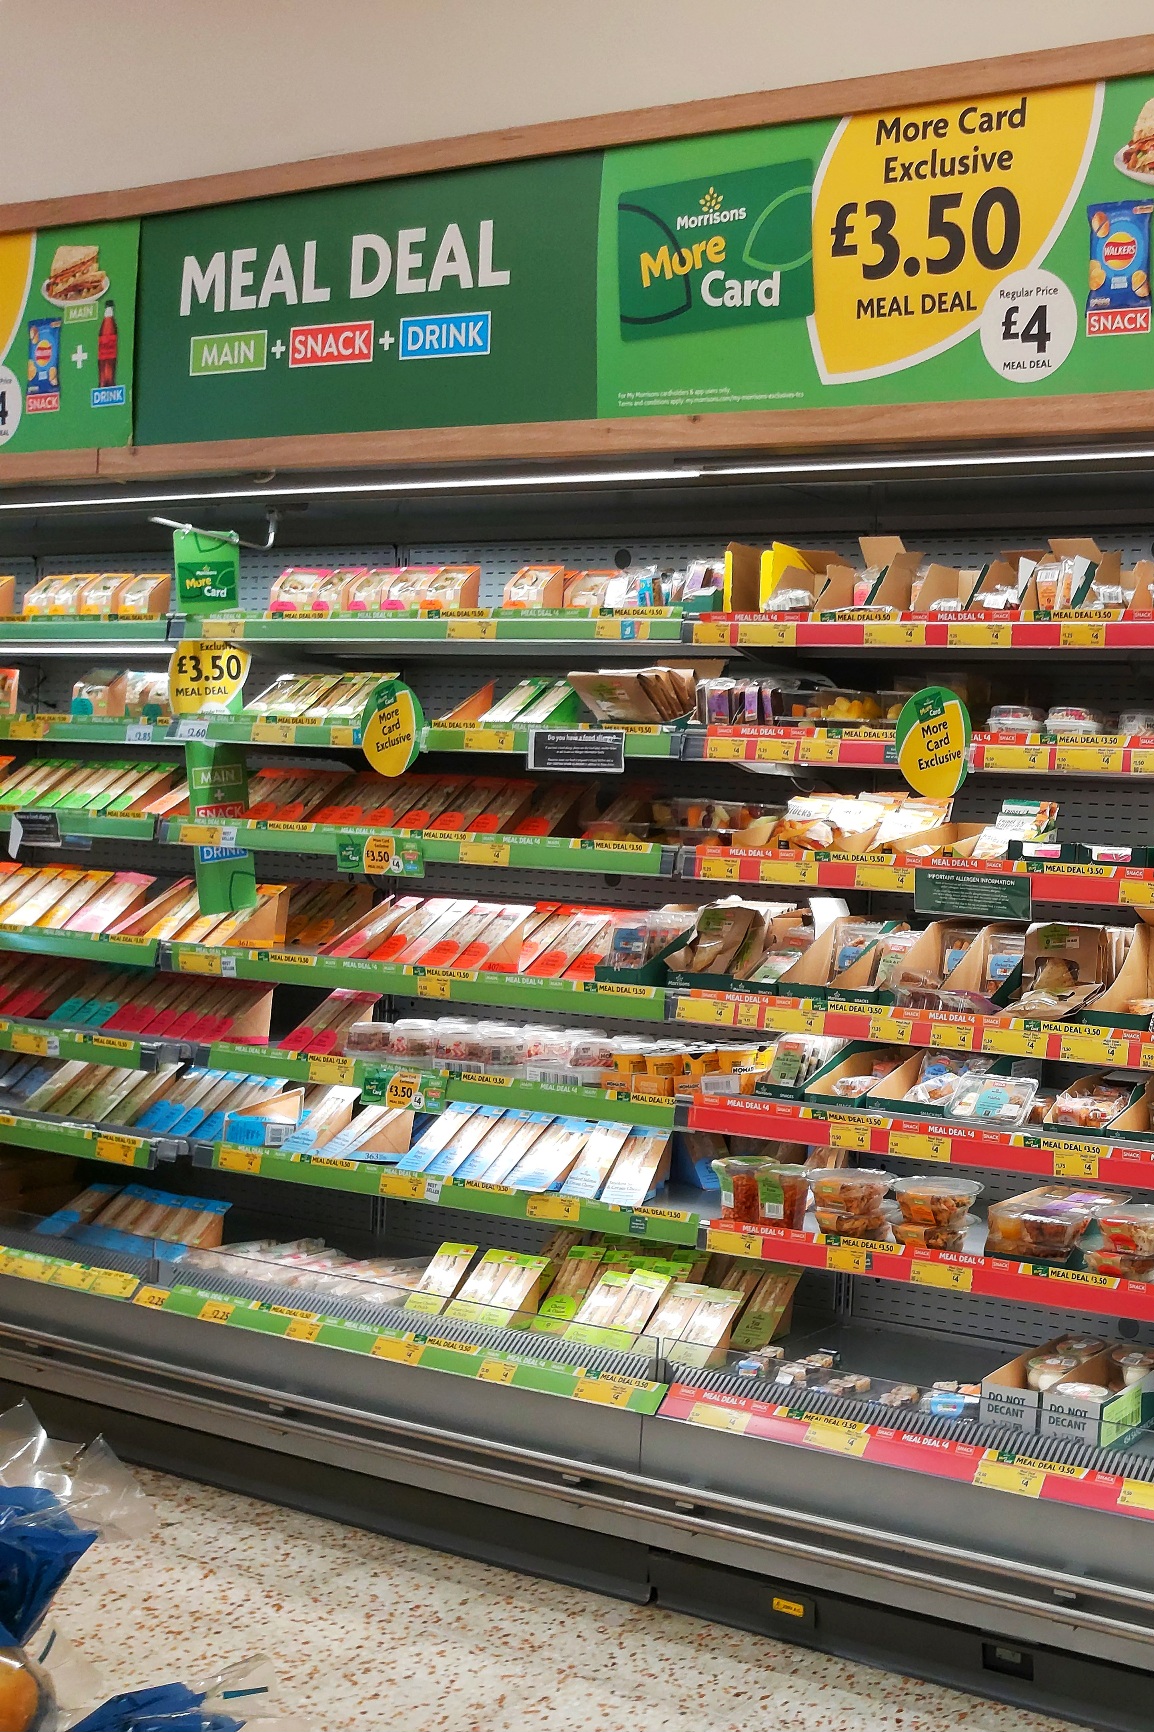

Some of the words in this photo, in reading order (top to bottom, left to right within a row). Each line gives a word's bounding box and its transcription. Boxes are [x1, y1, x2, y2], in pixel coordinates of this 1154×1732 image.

[875, 117, 949, 146] More
[958, 97, 1027, 135] Card
[883, 145, 1014, 184] Exclusive
[677, 206, 746, 230] Morrisons
[830, 186, 1021, 281] £3.50
[1104, 244, 1137, 258] WALKERS
[179, 240, 331, 316] MEAL
[349, 219, 511, 299] DEAL
[640, 235, 726, 288] More
[700, 270, 780, 307] Card
[1000, 289, 1033, 301] Regular
[1035, 285, 1059, 297] Price
[856, 296, 915, 319] MEAL
[921, 290, 978, 314] DEAL
[69, 305, 94, 320] MAIN
[1002, 305, 1051, 353] £4
[1090, 312, 1147, 332] SNACK
[200, 341, 255, 367] MAIN
[294, 327, 369, 360] SNACK
[407, 317, 484, 350] DRINK
[1002, 360, 1027, 371] MEAL
[1030, 358, 1053, 369] DEAL
[28, 396, 59, 411] SNACK
[93, 389, 123, 404] DRINK
[204, 586, 227, 598] Card
[178, 655, 241, 682] £3.50
[175, 687, 201, 697] MEAL
[205, 685, 229, 696] DEAL
[379, 708, 400, 724] More
[382, 720, 401, 735] Card
[922, 721, 948, 738] More
[376, 732, 411, 753] Exclusive
[927, 735, 950, 751] Card
[918, 748, 961, 771] Exclusive
[199, 769, 235, 784] MAIN
[199, 806, 243, 818] SNACK
[203, 847, 245, 860] DRINK
[366, 849, 390, 864] £3.50
[928, 873, 954, 882] IMPORTANT
[390, 1084, 413, 1099] £3.50
[988, 1392, 1003, 1404] DO
[1005, 1395, 1025, 1407] NOT
[987, 1404, 1025, 1419] DECANT
[1049, 1404, 1064, 1416] DO
[1067, 1406, 1088, 1418] NOT
[1048, 1416, 1086, 1431] DECANT
